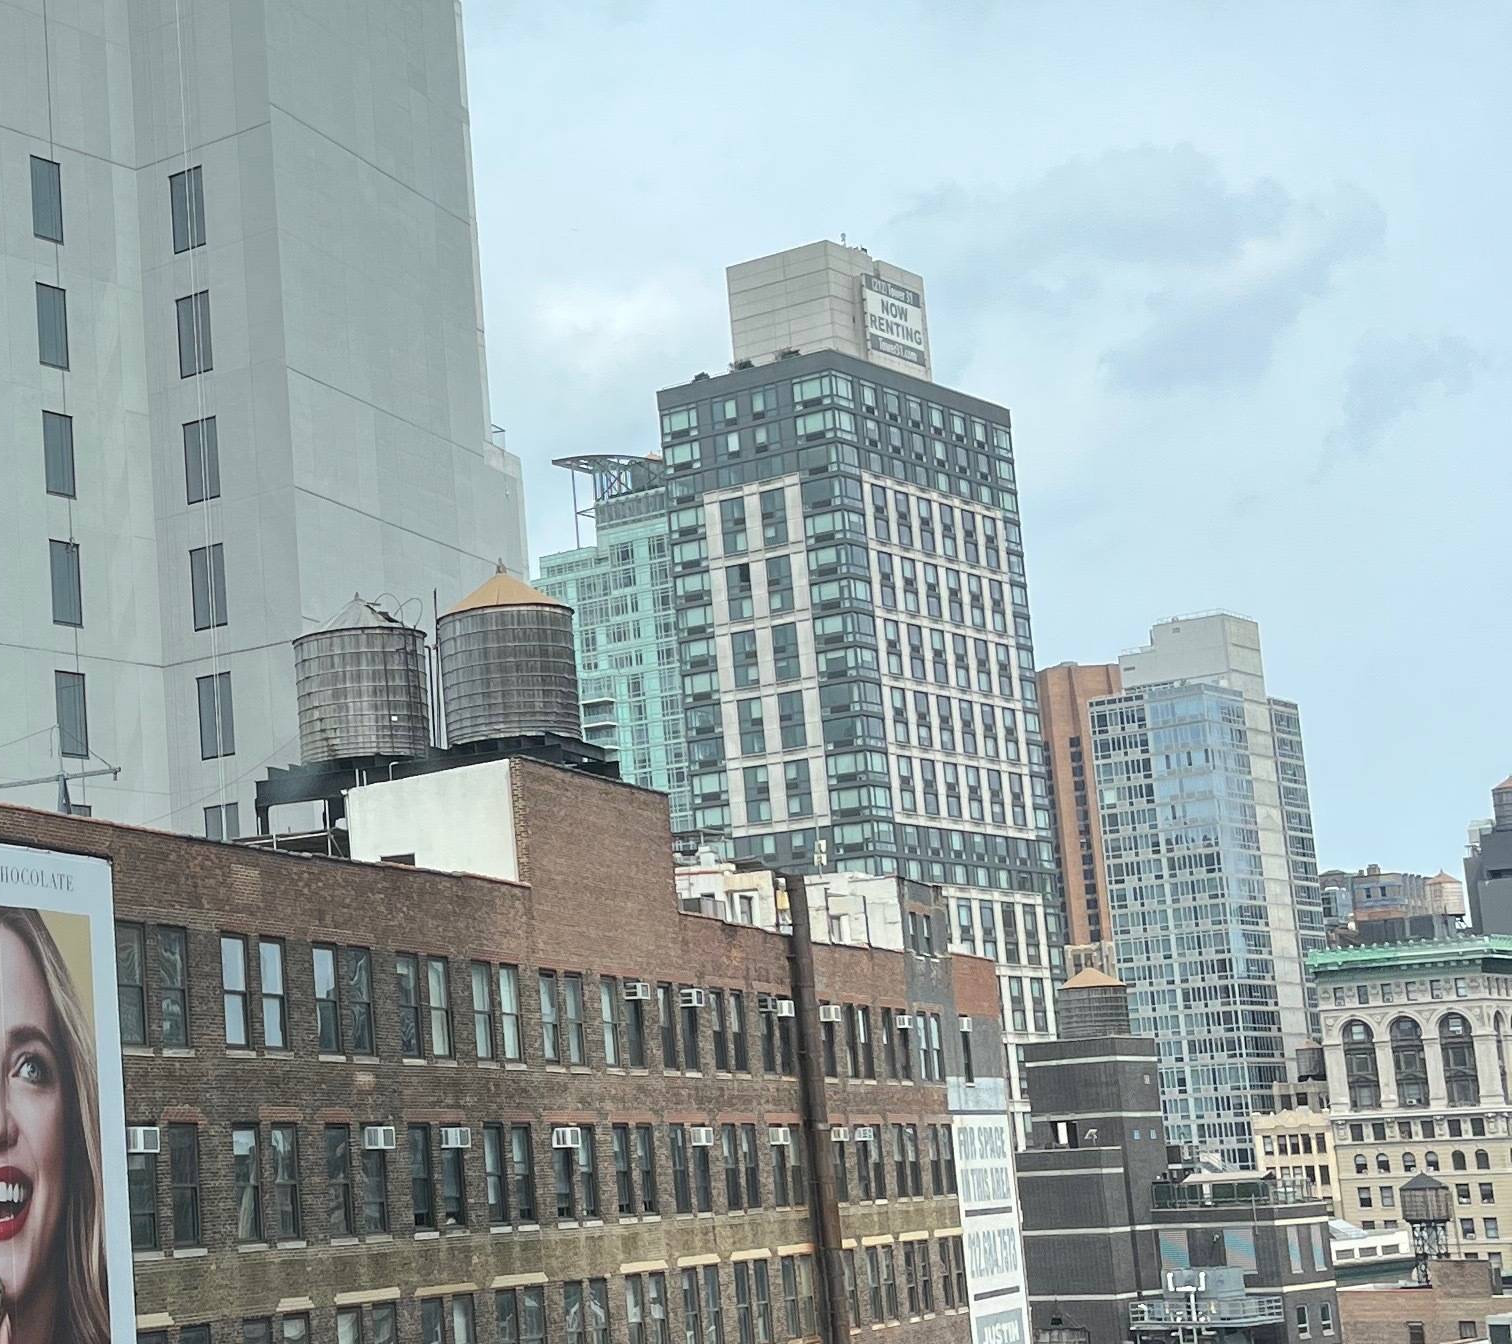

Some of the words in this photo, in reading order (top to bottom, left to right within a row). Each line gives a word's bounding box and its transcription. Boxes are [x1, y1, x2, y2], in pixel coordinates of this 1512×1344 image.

[881, 298, 908, 322] NOW
[869, 313, 922, 346] RENTING
[957, 1126, 977, 1161] FOR
[977, 1126, 1007, 1160] SPACE
[960, 1168, 972, 1203] IN
[970, 1168, 991, 1202] THIS
